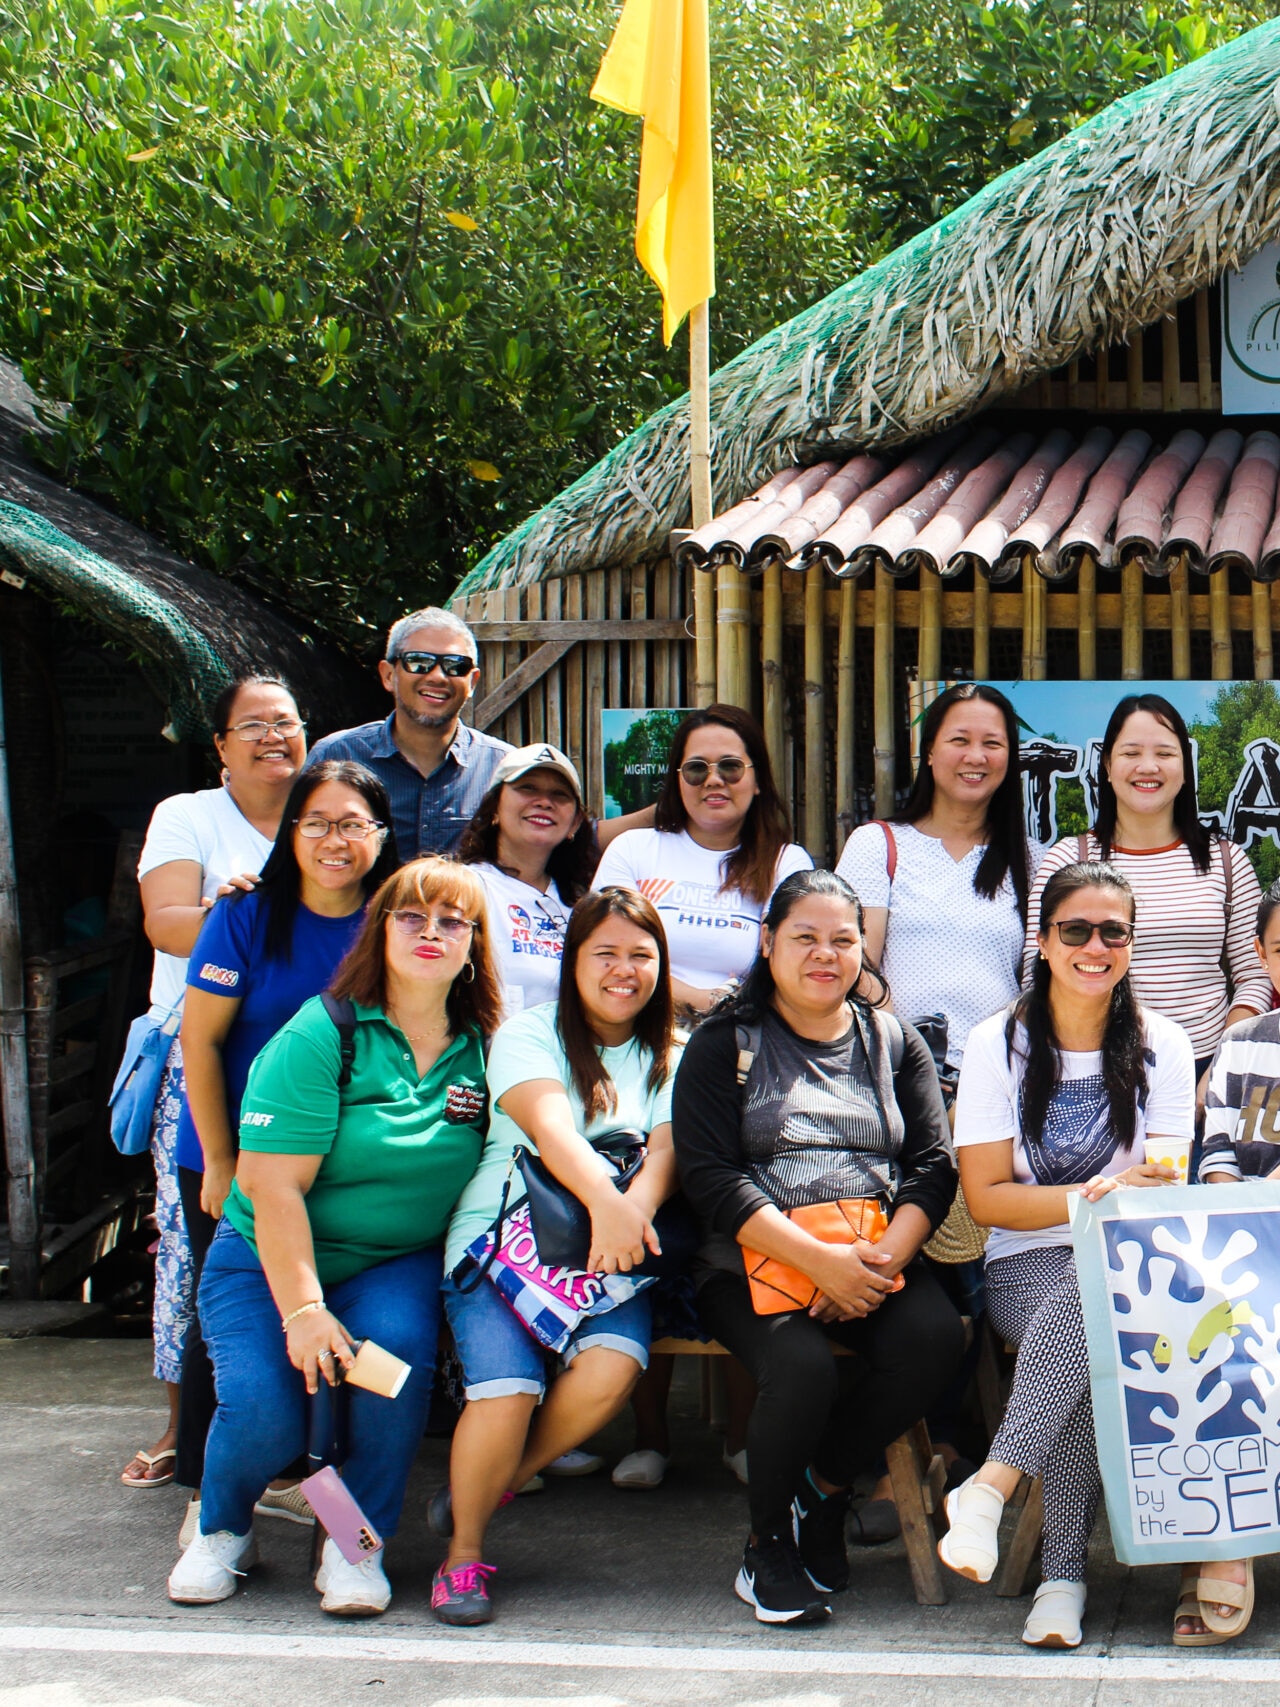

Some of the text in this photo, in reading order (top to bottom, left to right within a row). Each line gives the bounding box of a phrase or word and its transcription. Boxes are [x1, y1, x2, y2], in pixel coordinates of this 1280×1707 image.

[624, 763, 656, 775] MIGHTY
[1136, 1484, 1165, 1512] by
[1139, 1514, 1177, 1536] the
